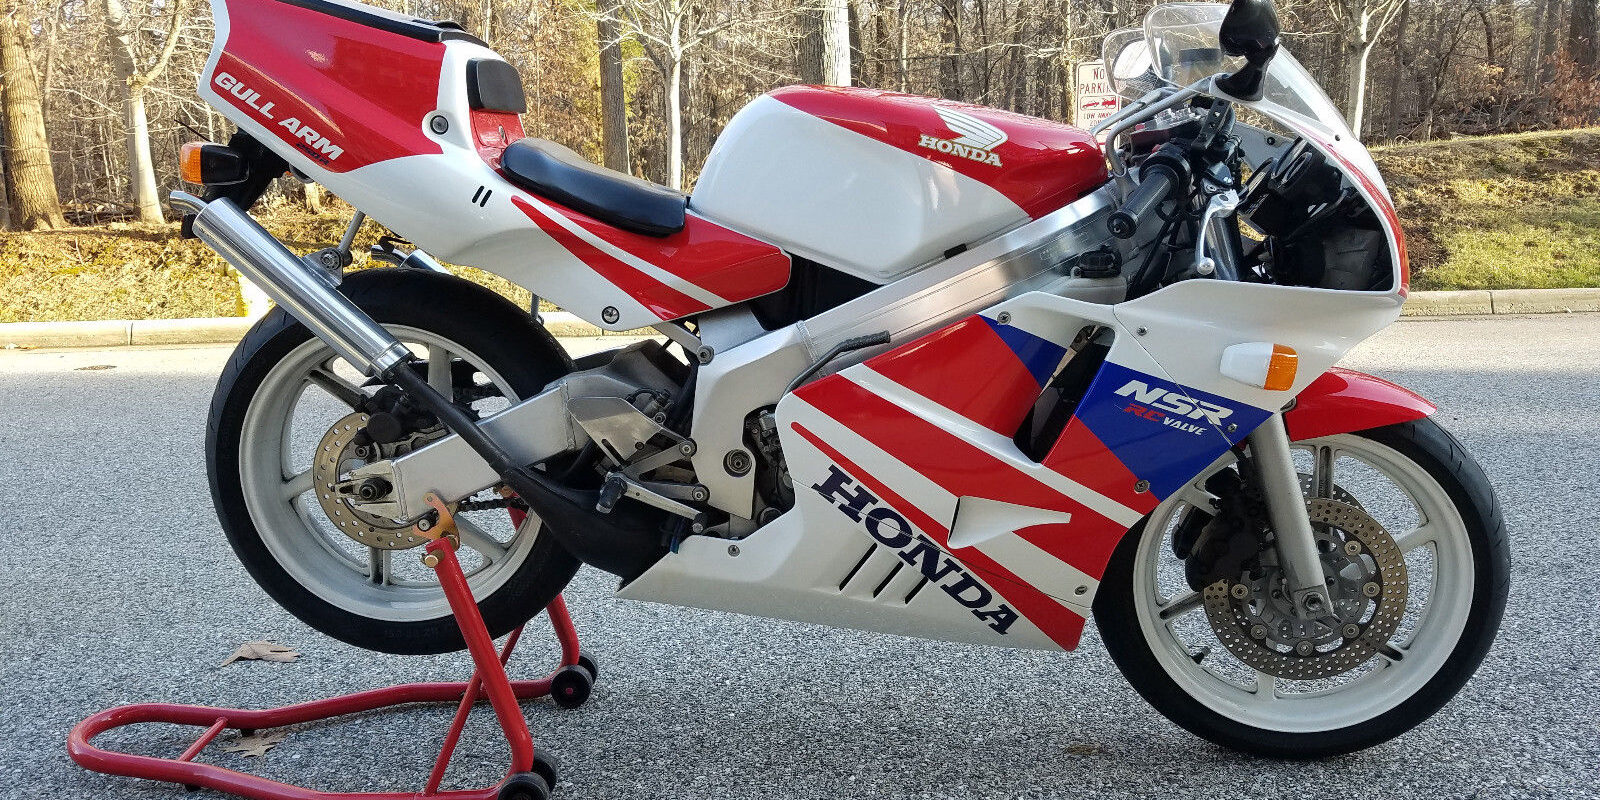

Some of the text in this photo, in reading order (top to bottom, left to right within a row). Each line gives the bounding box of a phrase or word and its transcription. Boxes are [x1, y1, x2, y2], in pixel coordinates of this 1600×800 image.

[1093, 68, 1105, 80] NO
[214, 71, 345, 161] GULL ARM
[918, 134, 1003, 168] HONDA
[1113, 379, 1234, 426] NSR
[1123, 402, 1208, 436] RC VALVE
[811, 464, 1020, 636] HONDA
